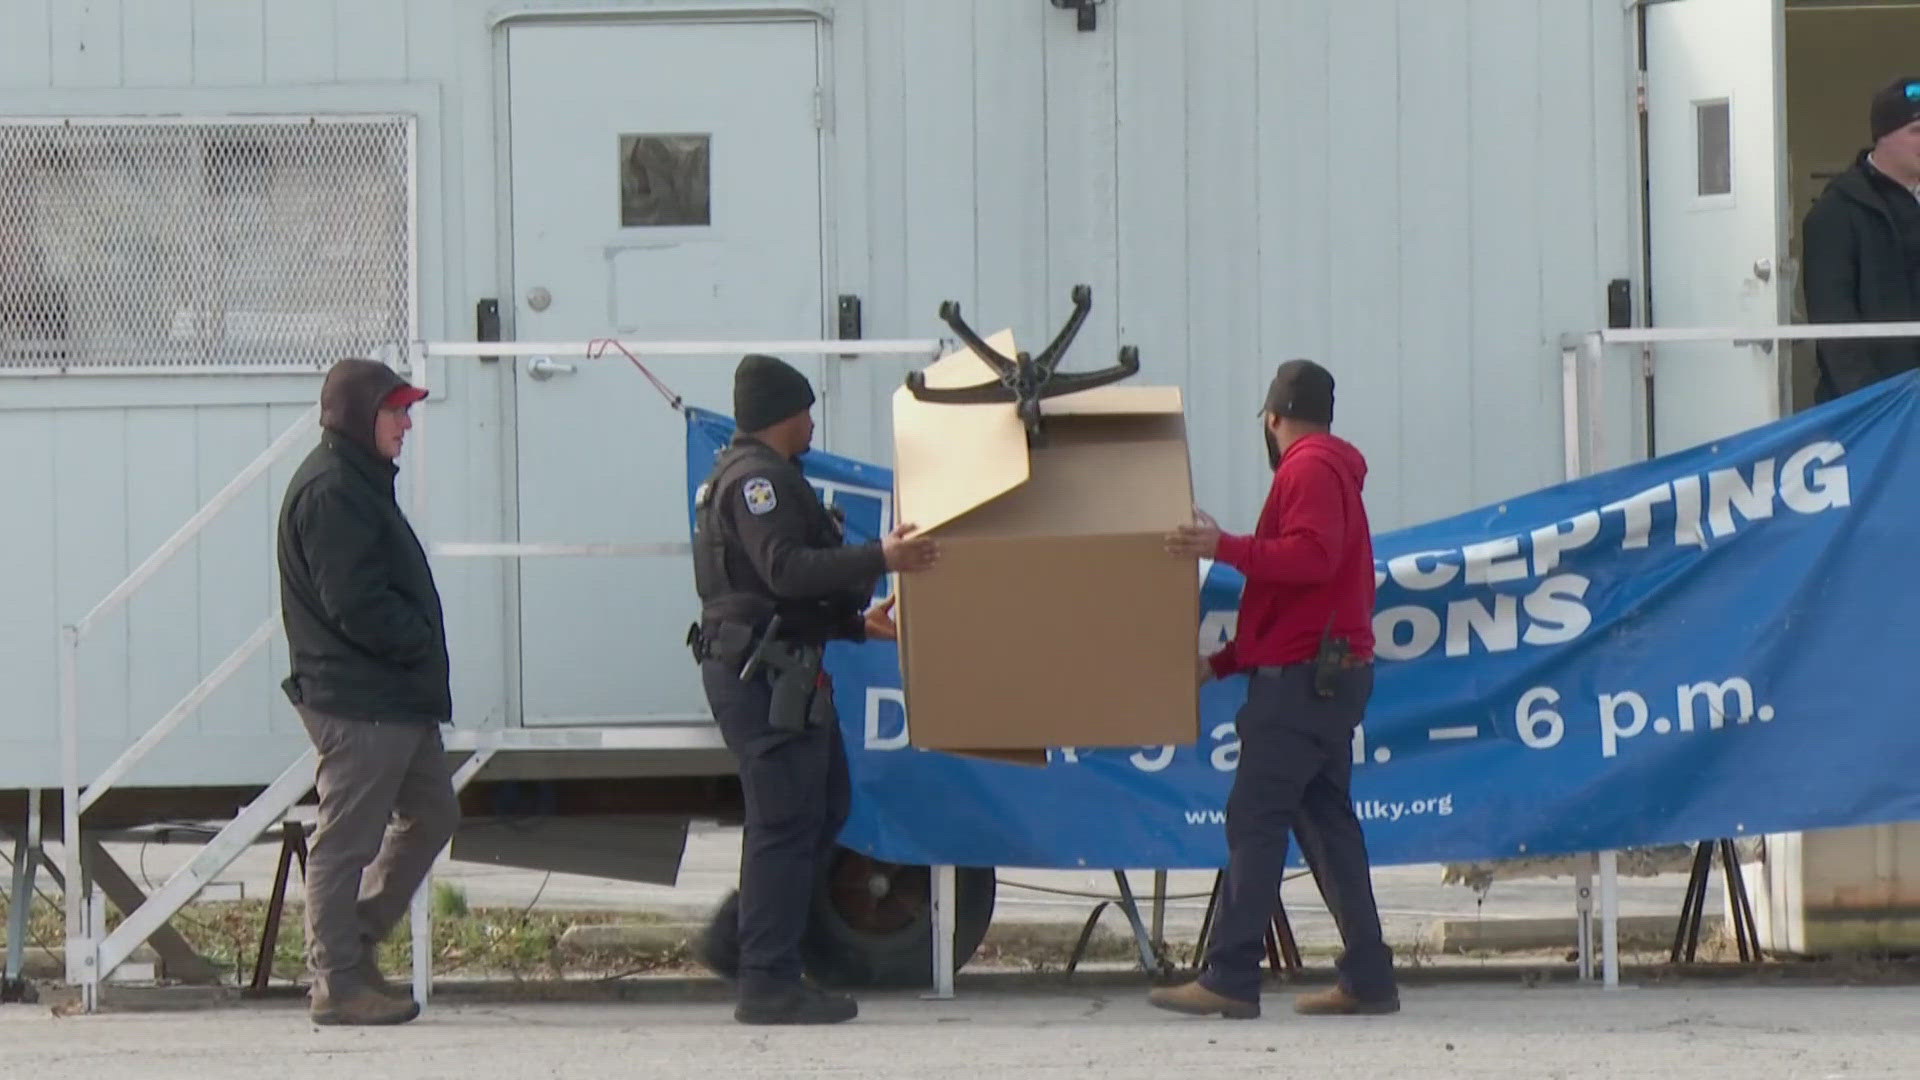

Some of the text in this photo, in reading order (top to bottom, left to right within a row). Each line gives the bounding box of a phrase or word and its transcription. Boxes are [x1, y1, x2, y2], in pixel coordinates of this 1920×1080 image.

[1240, 441, 1851, 592] CEPTING
[1514, 686, 1565, 750] 6
[1599, 674, 1775, 758] p.m.
